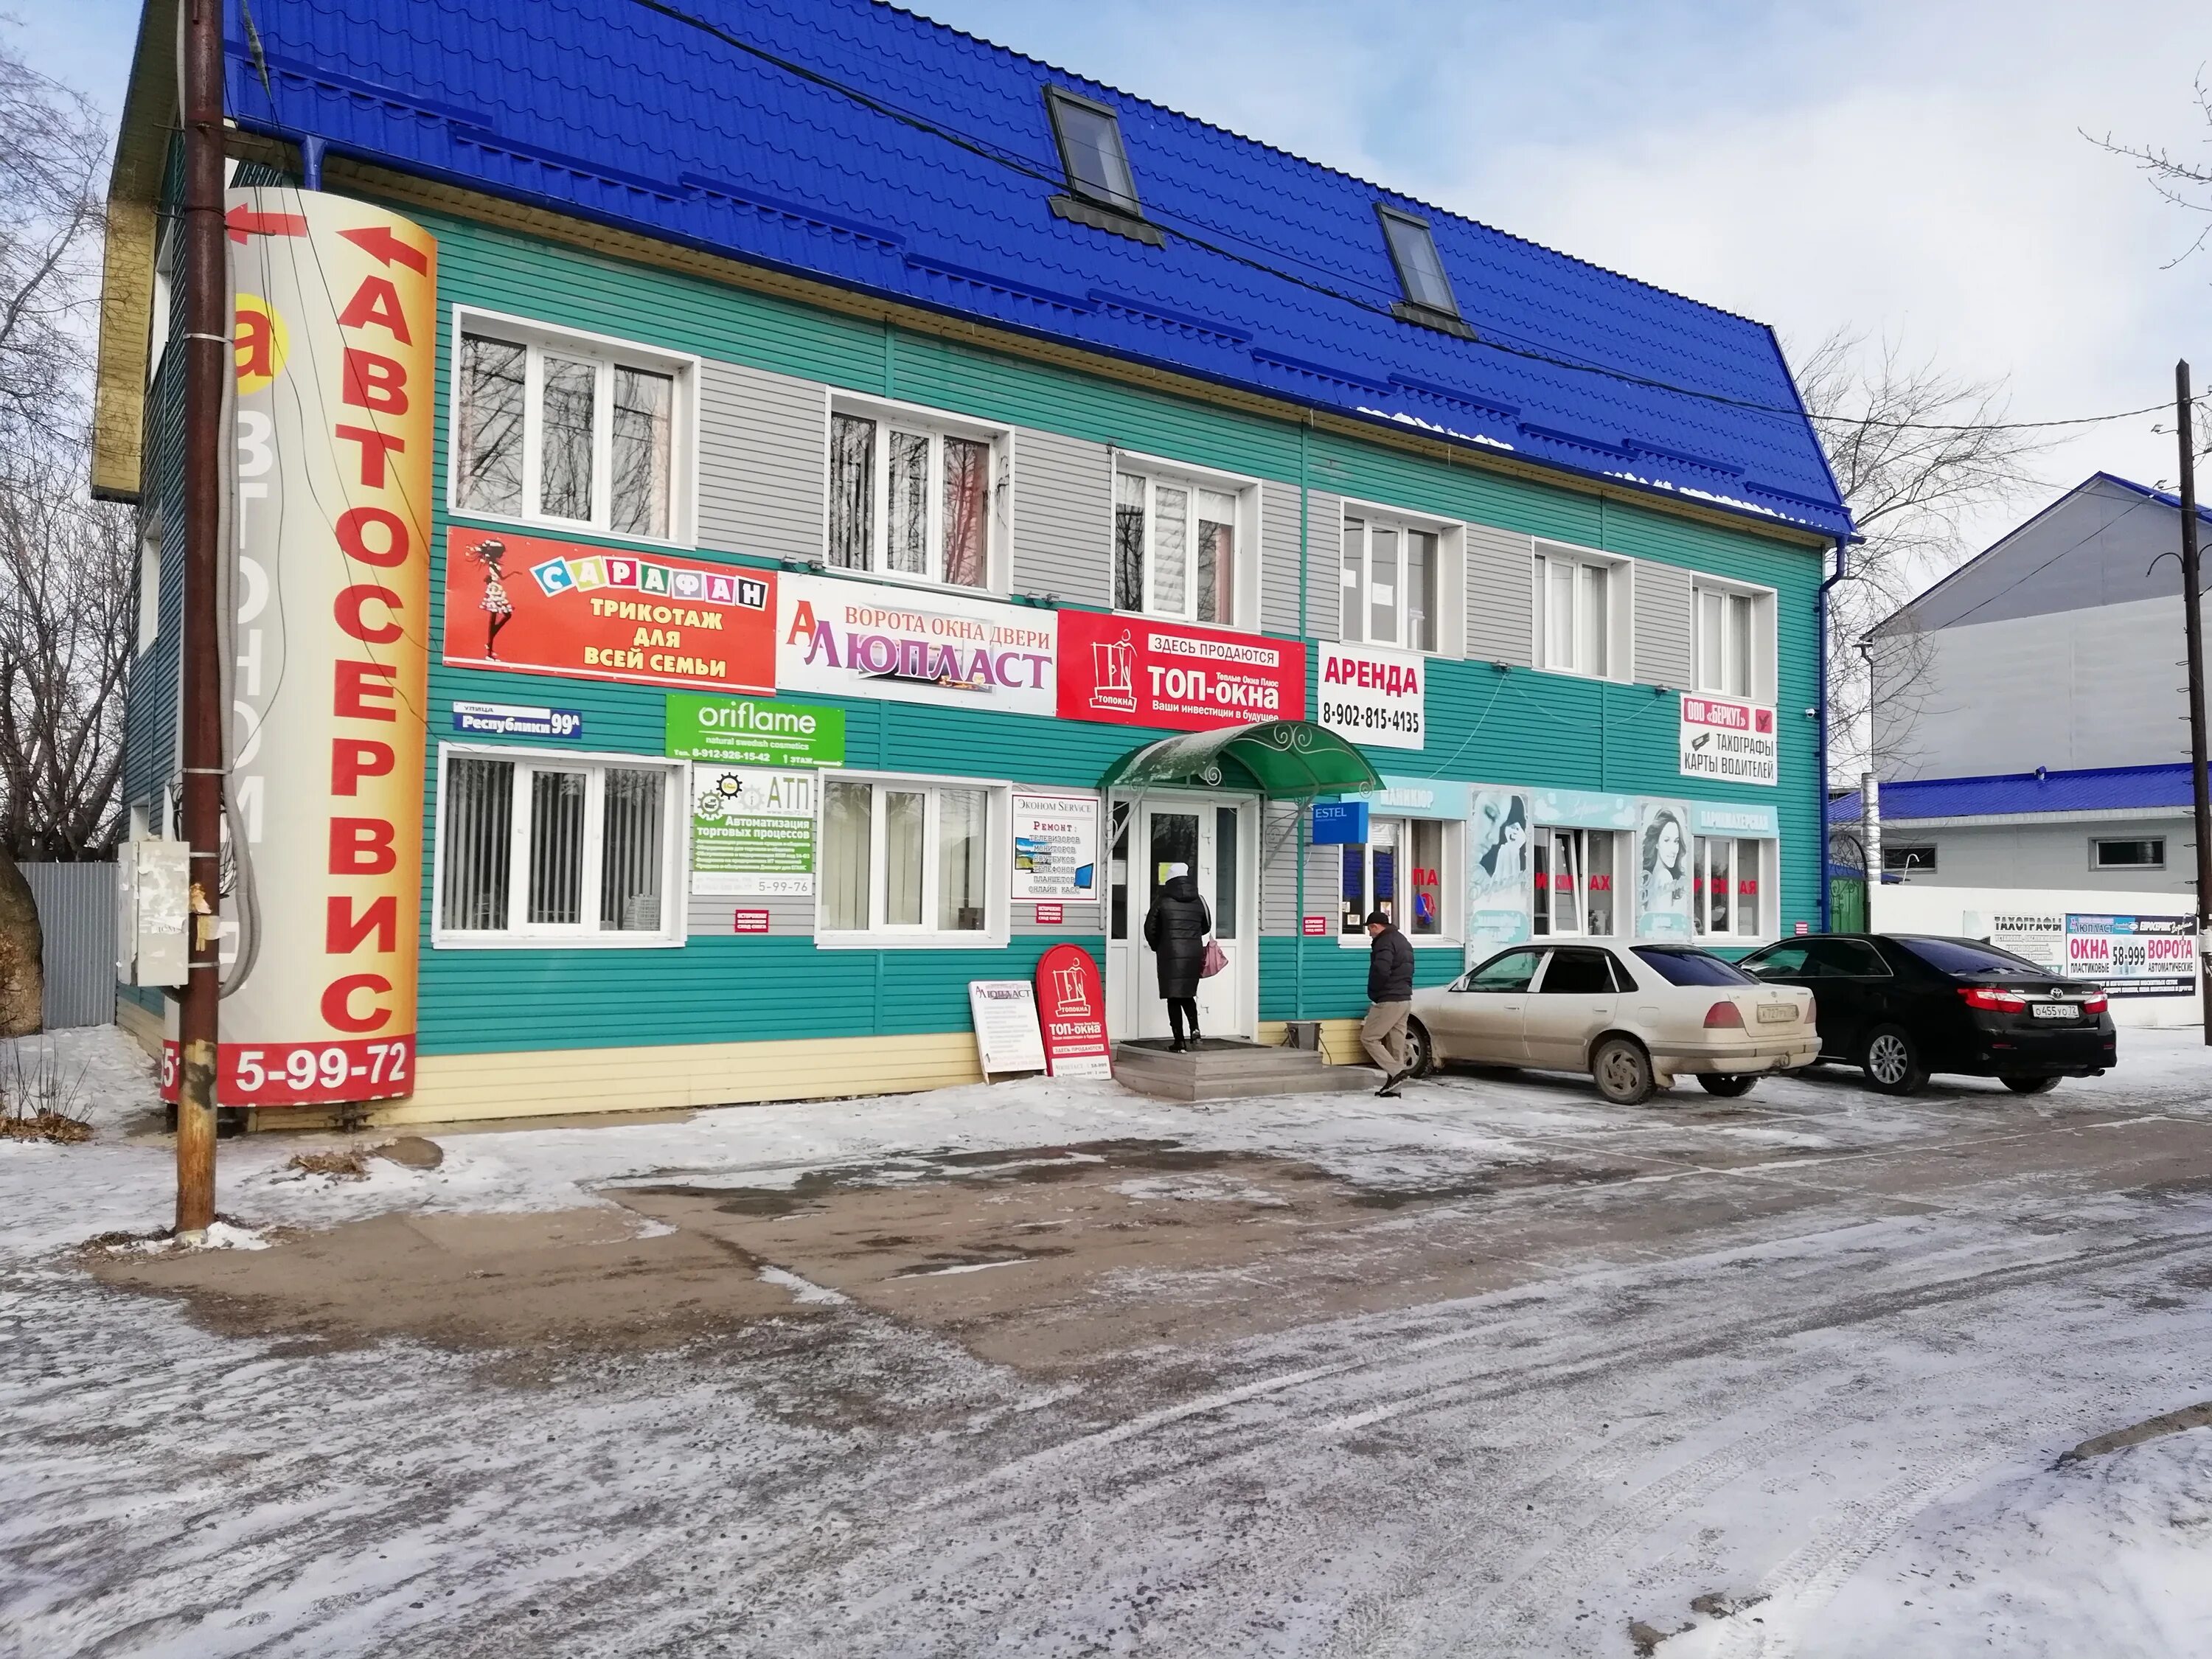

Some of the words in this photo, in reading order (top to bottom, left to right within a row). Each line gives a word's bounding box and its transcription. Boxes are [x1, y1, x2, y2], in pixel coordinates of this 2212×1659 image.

[543, 561, 761, 605] САРАФАН
[590, 598, 723, 630] ТРИКОТАЖ
[633, 627, 681, 649] ДЛЯ
[845, 605, 926, 633] ВОРОТА
[931, 618, 985, 641] ОКНА
[990, 626, 1051, 650] ДВЕРИ
[321, 276, 411, 1033] АВТОСЕРВИС
[786, 599, 1054, 690] АЛЮПЛАСТ
[1154, 636, 1194, 655] ЗДЕСЬ
[1199, 641, 1275, 665] ПРОДАЮТСЯ
[584, 647, 644, 669] ВСЕЙ
[650, 653, 726, 678] СЕМЬИ
[1147, 665, 1279, 710] ТОП-окна
[1242, 675, 1259, 685] Окна
[1261, 678, 1279, 687] Плюс
[1324, 655, 1419, 698] АРЕНДА
[1098, 695, 1133, 707] ТОПОКНА
[1152, 700, 1179, 713] Ваши
[1180, 704, 1234, 719] инвестиции
[1235, 711, 1241, 719] в
[1242, 709, 1279, 723] будущее
[462, 714, 551, 734] Республики
[698, 700, 817, 734] oriflame
[1322, 702, 1420, 734] 8-902-815-4135
[1687, 700, 1705, 722] ООО
[1706, 704, 1747, 728] «БЕРКУТ»
[706, 736, 734, 745] natural
[736, 740, 768, 748] swedish
[770, 742, 810, 751] cosmetics
[1717, 733, 1774, 757] ТАХОГРАФЫ
[692, 748, 771, 762] 8-912-926-15-42
[790, 757, 814, 765] ЭТАЖ
[1685, 752, 1718, 773] КАРТЫ
[1722, 757, 1774, 779] ВОДИТЕЛЕЙ
[766, 776, 809, 810] АТП
[725, 815, 810, 830] Автоматизация
[1315, 807, 1347, 818] ESTEL
[697, 827, 752, 838] торговых
[753, 828, 810, 840] процессов
[1029, 835, 1080, 844] ТЕЛЕВИЗОРОВ
[1034, 845, 1077, 854] МОНИТОРОВ
[1034, 855, 1077, 864] НОУТБУКОВ
[1033, 876, 1075, 884] ПЛАНШЕТОВ
[1034, 866, 1075, 874] ТЕЛЕФОНОВ
[759, 881, 808, 892] 5-99-76
[1029, 886, 1057, 894] ОНЛАЙН
[1061, 886, 1080, 894] КАСС
[1994, 916, 2062, 932] ТАХОГРАФЫ
[2070, 939, 2109, 959] ОКНА
[2112, 946, 2146, 966] 58-999
[2148, 939, 2193, 959] ВОРОТА
[2070, 963, 2110, 973] ПЛАСТИКОВЫЕ
[2148, 961, 2193, 973] АВТОМАТИЧЕСКИЕ
[1048, 1023, 1102, 1036] ТОП-окна
[236, 1042, 407, 1091] 5-99-72
